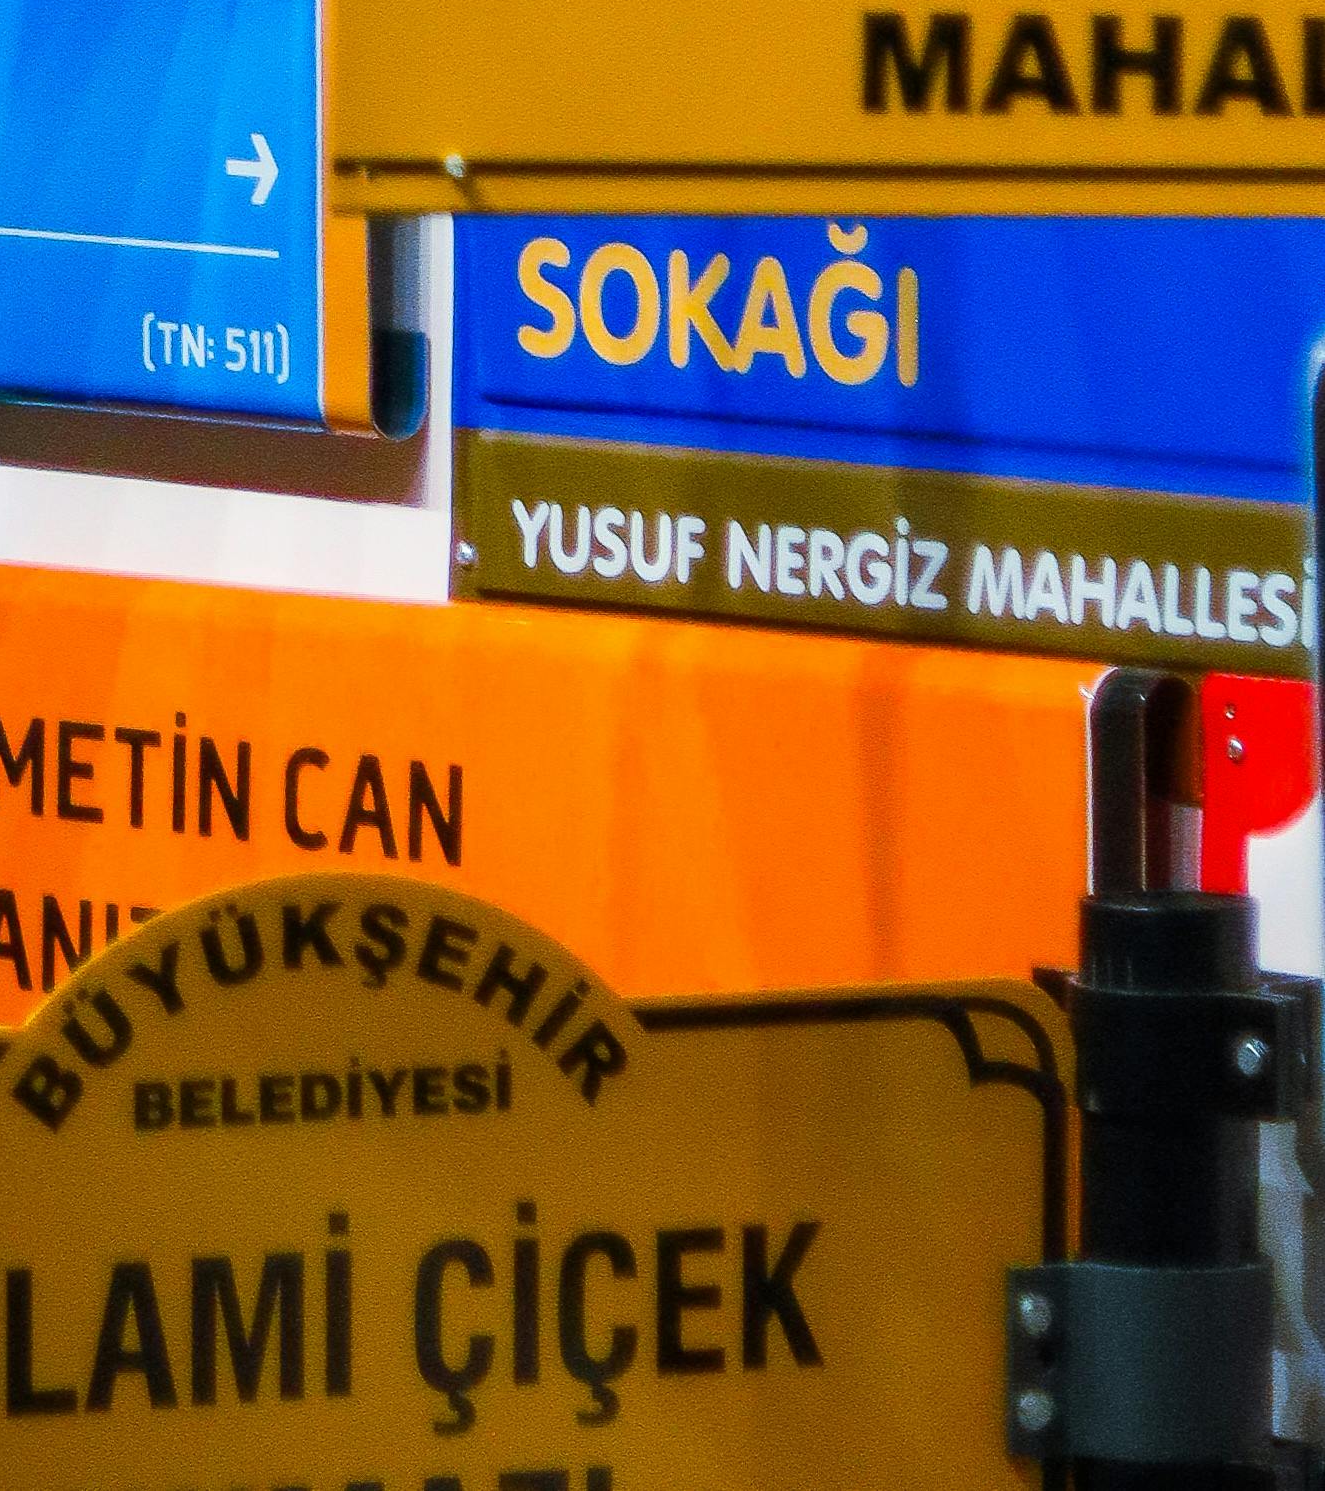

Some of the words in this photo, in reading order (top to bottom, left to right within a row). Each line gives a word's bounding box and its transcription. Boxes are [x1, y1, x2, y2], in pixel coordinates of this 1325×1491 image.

[223, 320, 291, 383] 511)
[515, 221, 920, 389] SOKAĞI
[510, 497, 707, 587] YUSUF
[727, 517, 949, 612] NERGİZ
[282, 746, 464, 867] CAN
[10, 896, 629, 1131] BÜYÜKŞEHİR
[132, 1048, 513, 1134] BELEDİYESİ
[412, 1200, 824, 1437] ÇİÇEK
